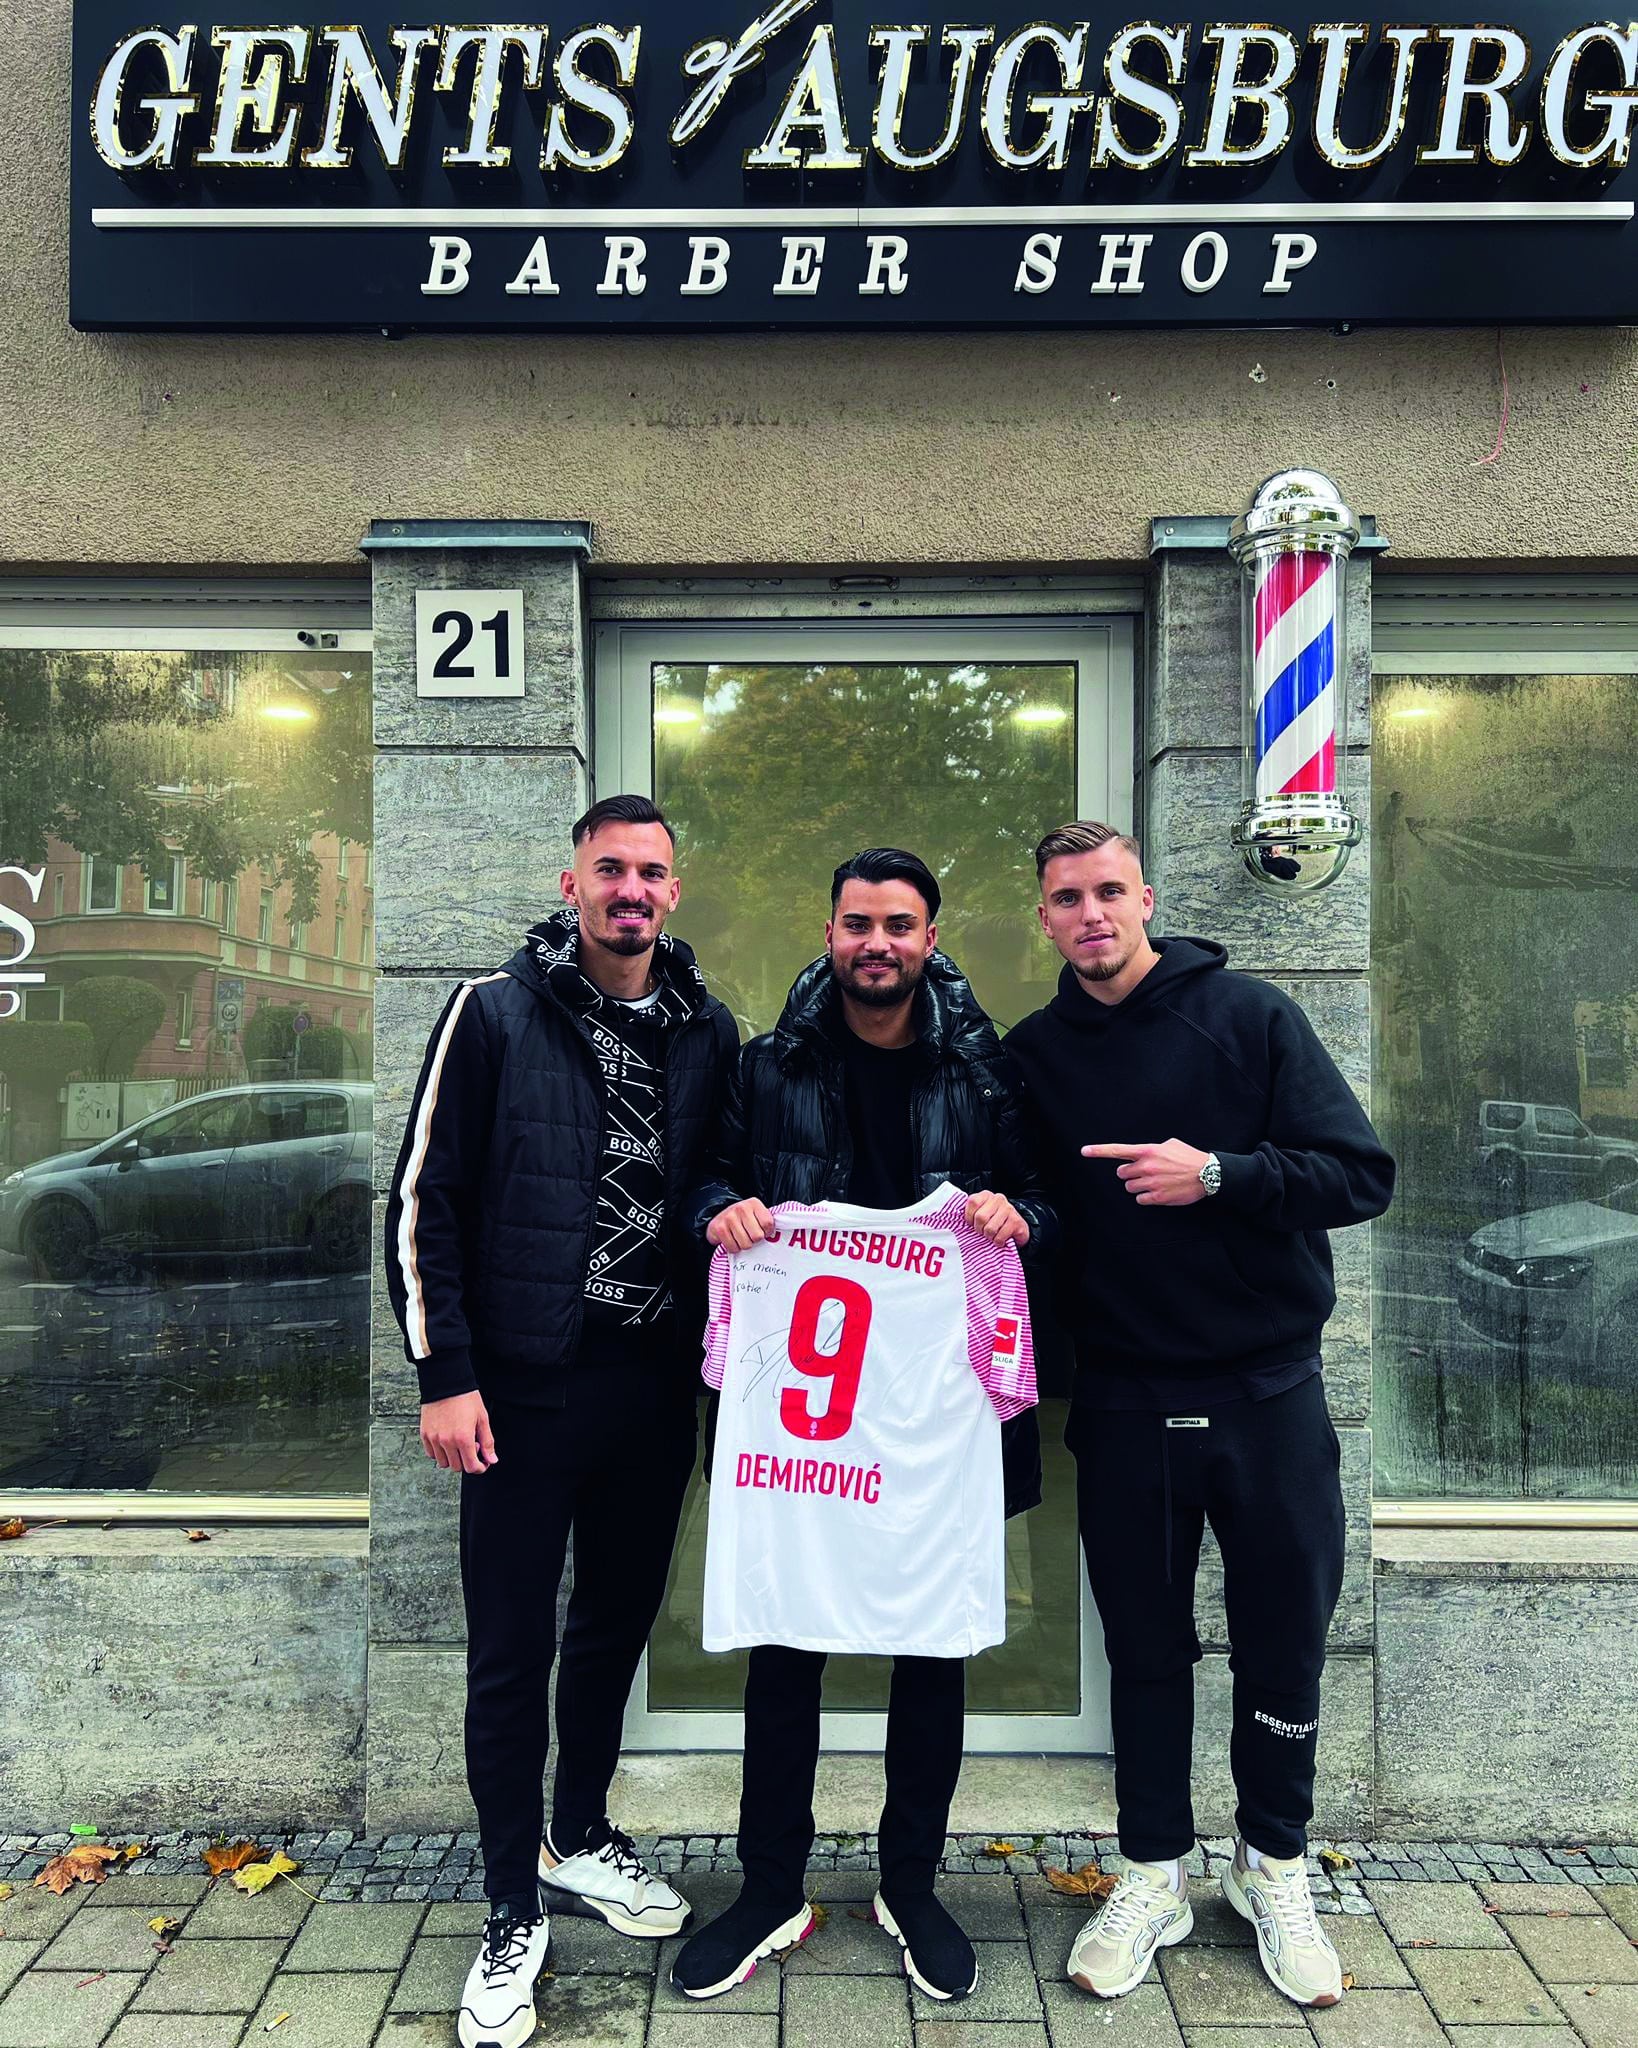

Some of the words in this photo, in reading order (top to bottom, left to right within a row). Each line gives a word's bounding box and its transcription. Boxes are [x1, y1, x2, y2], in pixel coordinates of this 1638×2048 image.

[90, 24, 644, 172] GENTS
[667, 0, 818, 148] of
[741, 20, 1638, 171] AUGSBURG
[420, 235, 910, 296] BARBER
[1014, 232, 1318, 294] SHOP
[432, 609, 510, 679] 21
[647, 1136, 665, 1170] BOS
[627, 1205, 661, 1234] BOS
[788, 1228, 947, 1279] AUGSBURG
[779, 1274, 873, 1441] 9
[735, 1452, 883, 1505] DEMIROVIĆ
[1254, 1710, 1318, 1733] ESSENTIALS
